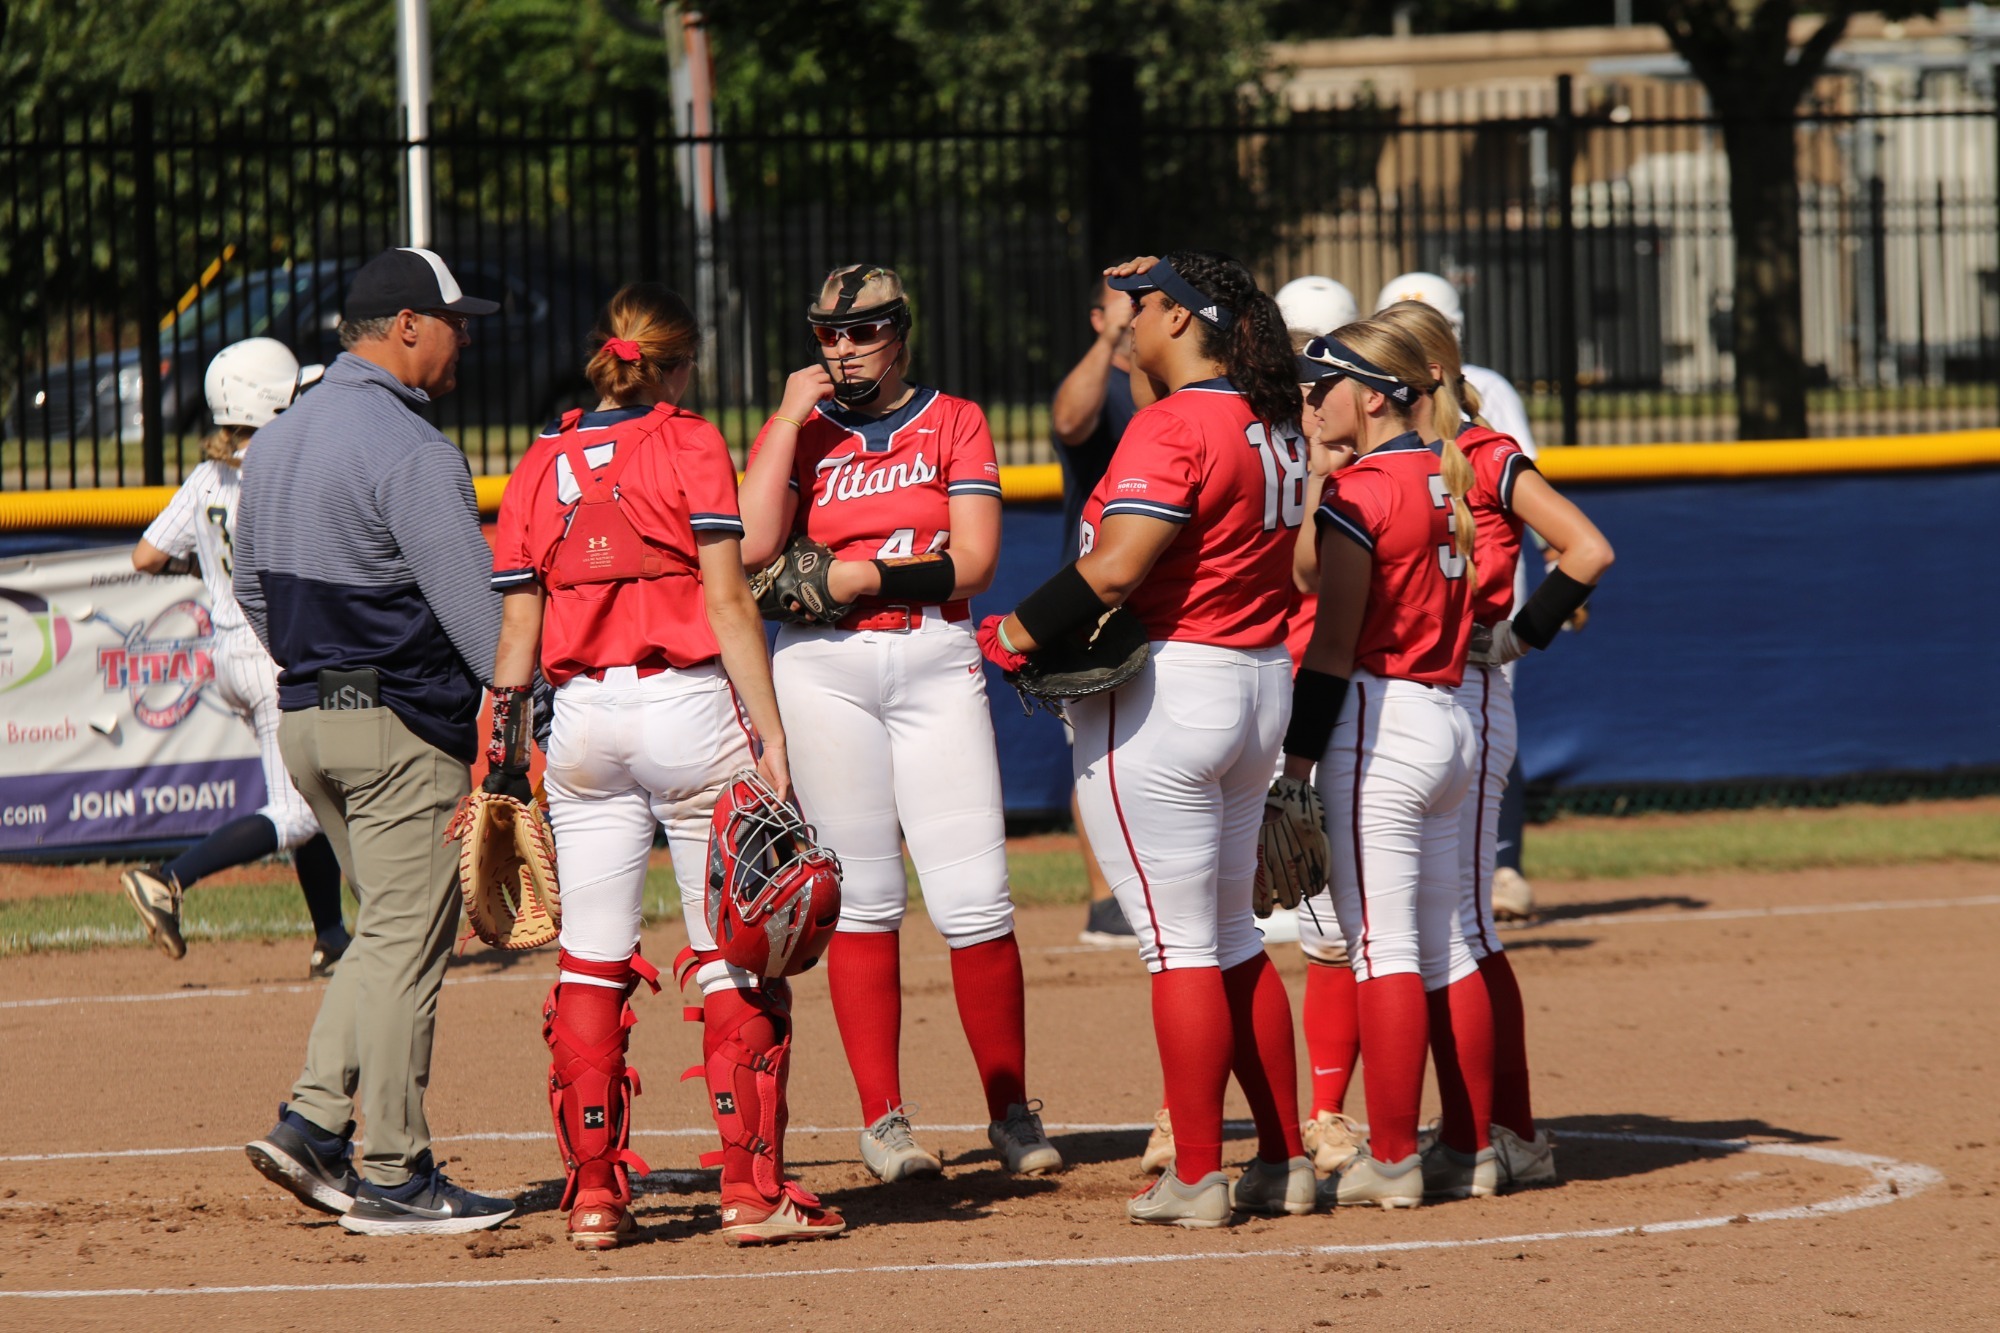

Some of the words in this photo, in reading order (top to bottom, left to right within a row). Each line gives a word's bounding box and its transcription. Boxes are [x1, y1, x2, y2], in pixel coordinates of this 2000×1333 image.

[815, 452, 936, 507] Titans
[1117, 482, 1148, 490] HORIZON
[1244, 421, 1308, 533] 18
[8, 717, 76, 744] Branch
[69, 790, 135, 821] JOIN
[142, 780, 236, 812] TODAY!
